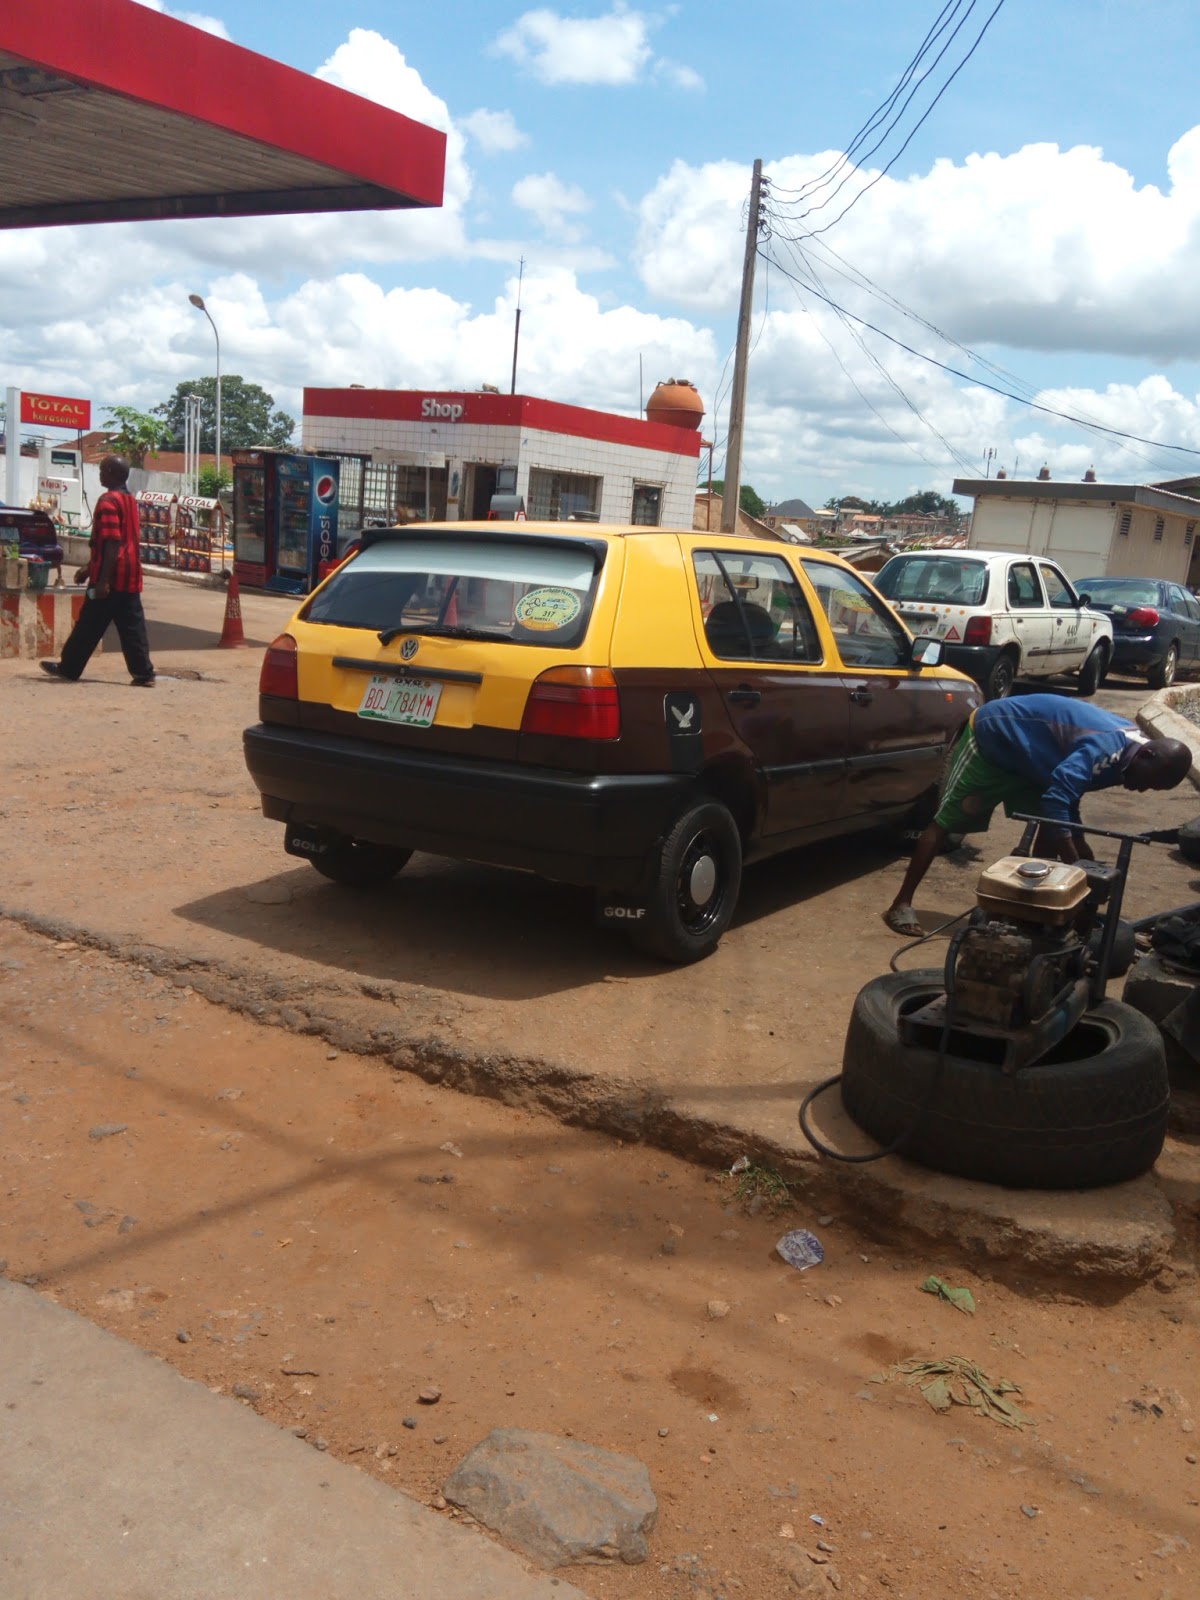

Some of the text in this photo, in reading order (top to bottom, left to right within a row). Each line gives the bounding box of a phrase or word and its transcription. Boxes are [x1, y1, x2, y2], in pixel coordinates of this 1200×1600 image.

[26, 396, 84, 415] TOTAL
[421, 399, 463, 422] Shop
[32, 411, 78, 425] kerosene
[140, 491, 169, 502] TOTAL
[182, 496, 212, 508] TOTAL
[292, 838, 328, 853] GOLF
[604, 906, 646, 919] GOLF
